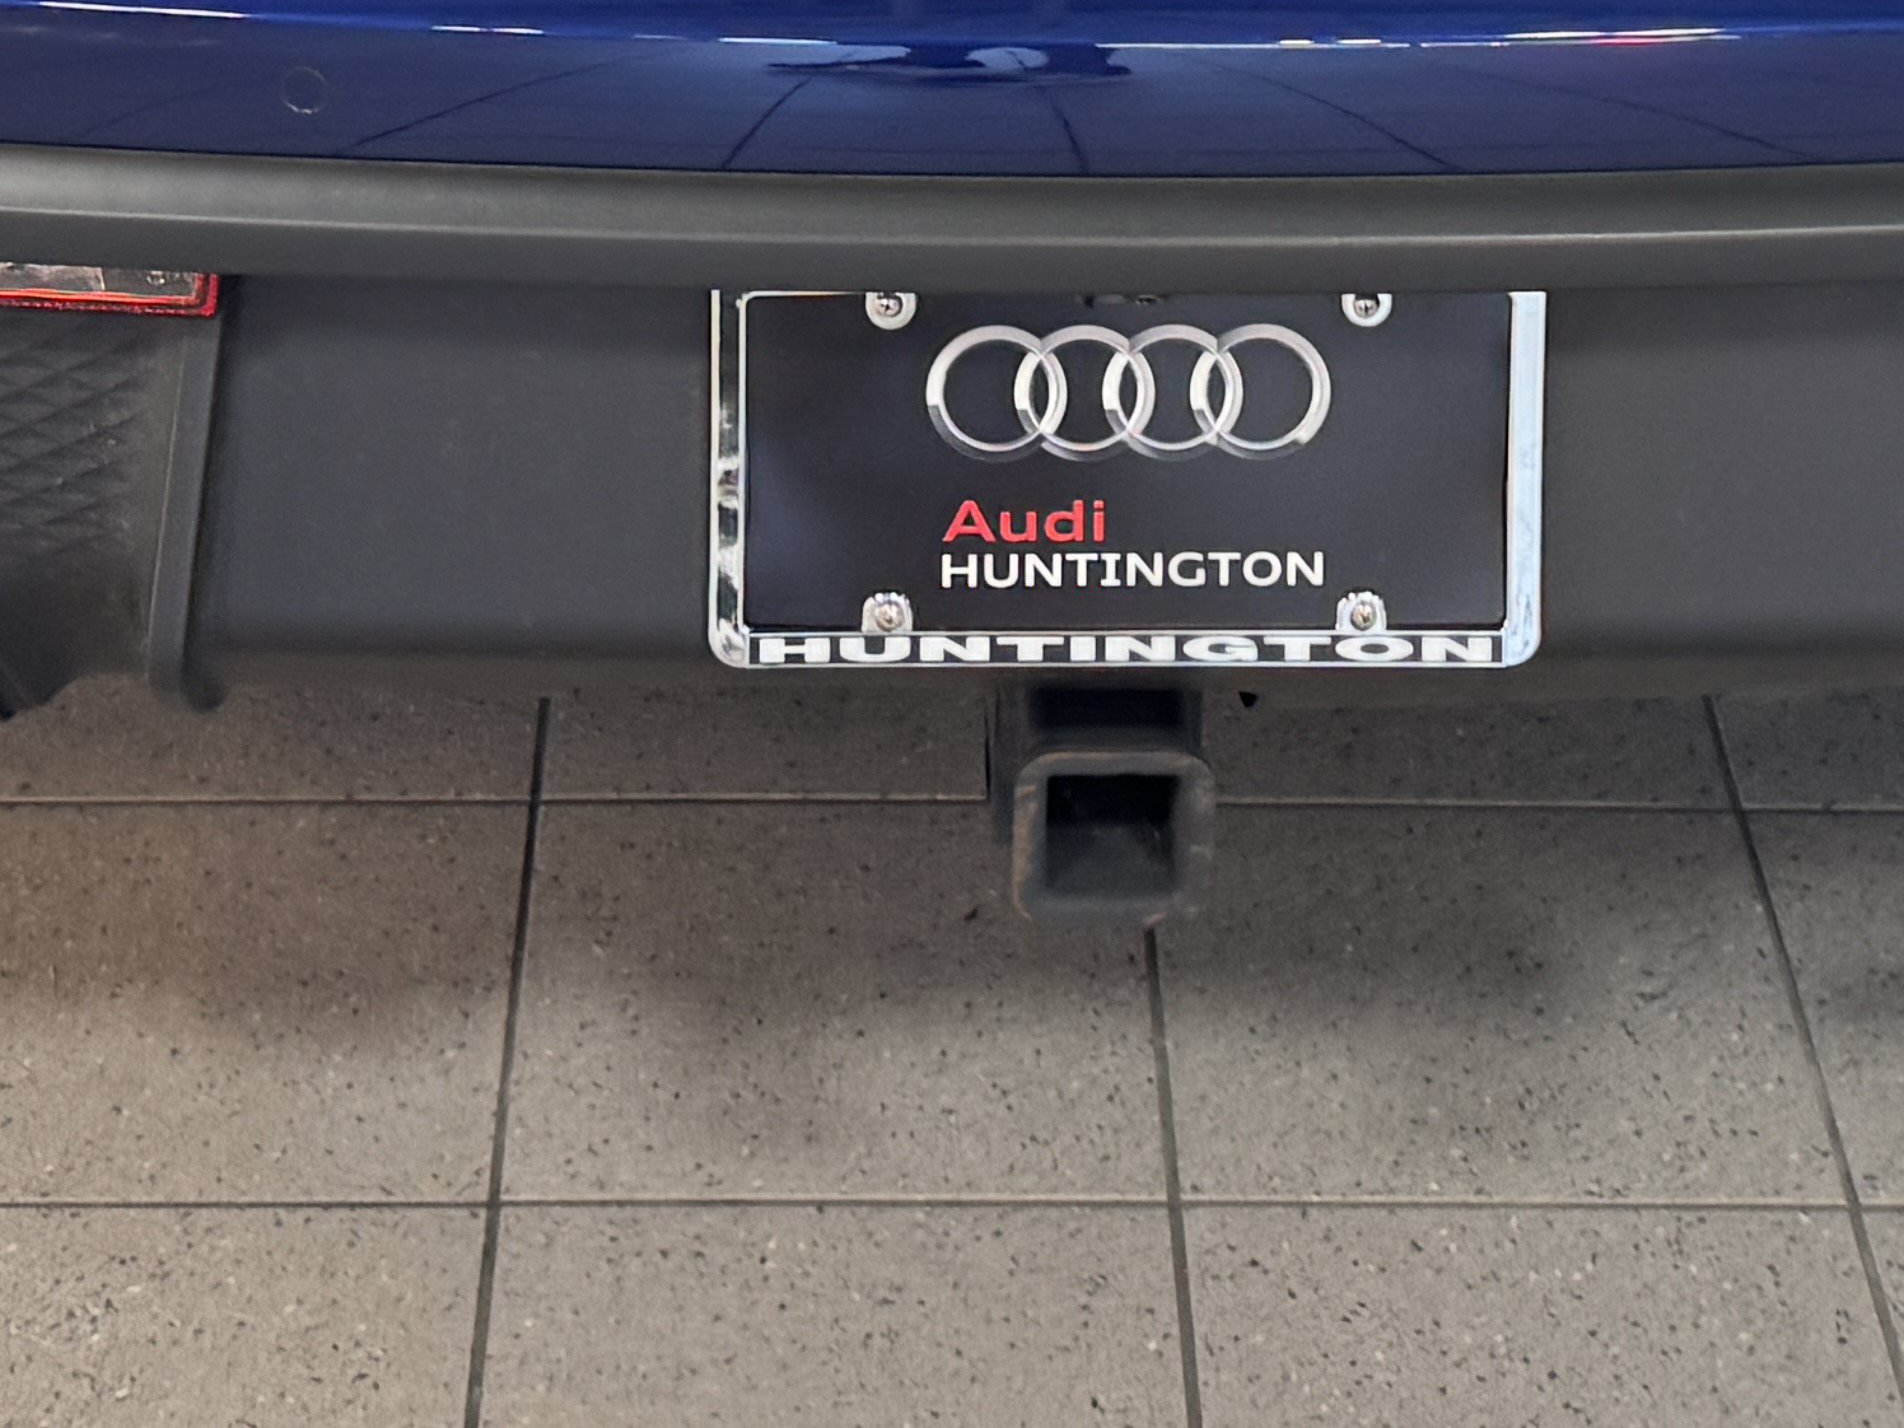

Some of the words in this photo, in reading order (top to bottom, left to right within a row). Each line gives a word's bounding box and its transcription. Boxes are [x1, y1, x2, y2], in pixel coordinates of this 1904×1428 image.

[942, 499, 1106, 542] Audi
[941, 551, 1325, 589] HUNTINGTON
[758, 635, 1494, 665] HUNTINGTON
